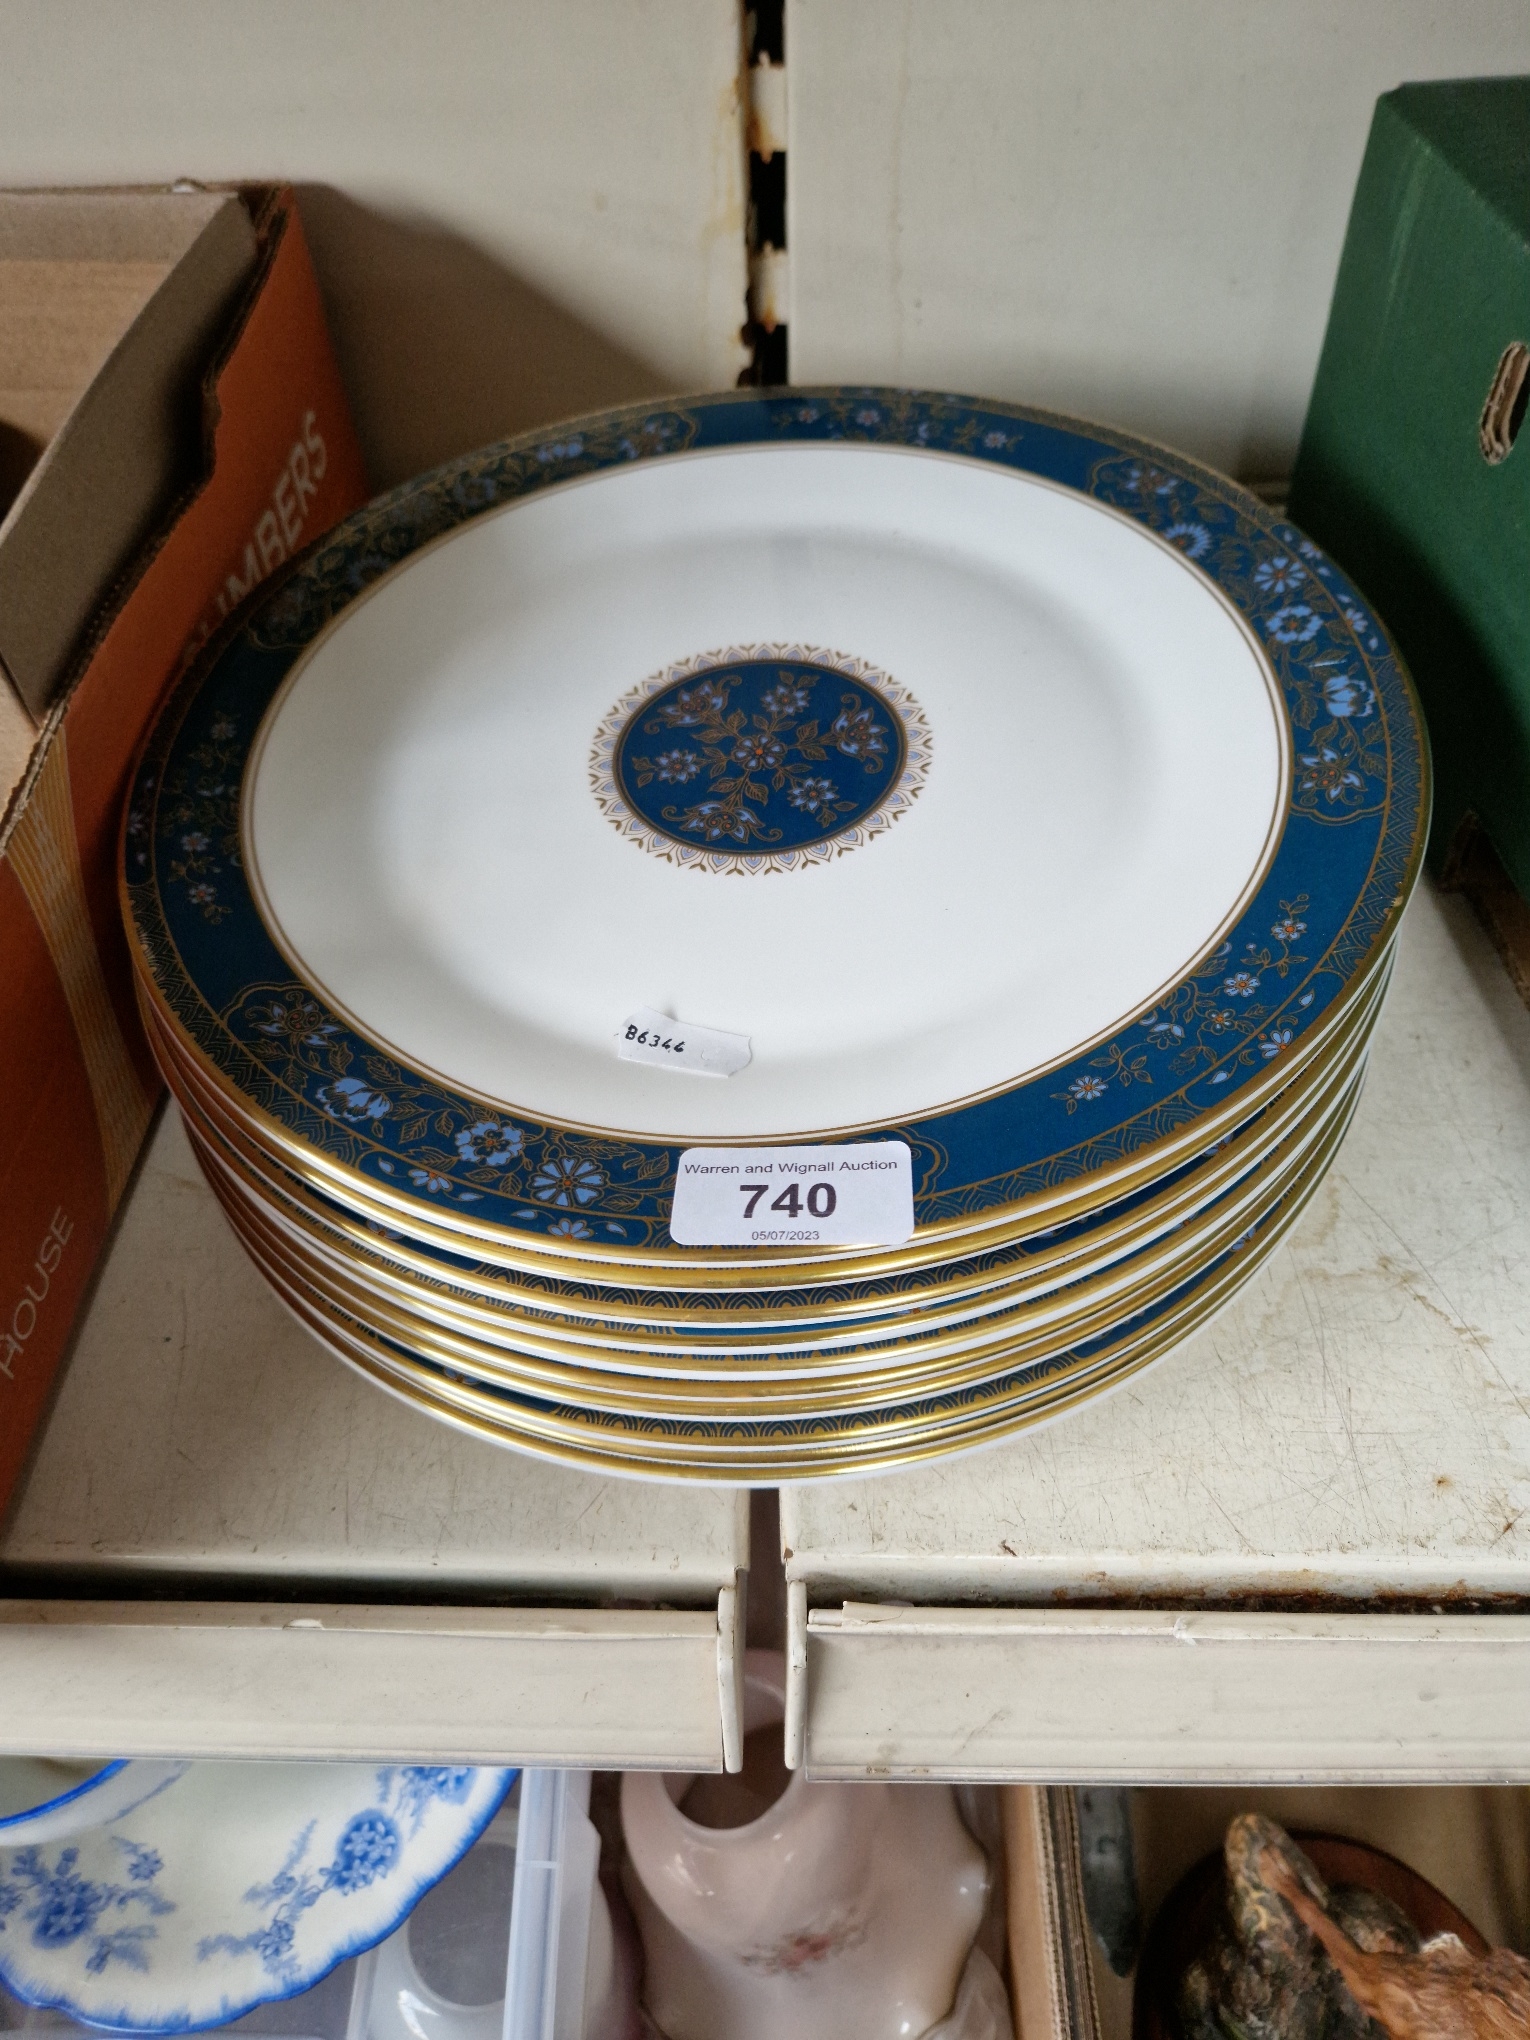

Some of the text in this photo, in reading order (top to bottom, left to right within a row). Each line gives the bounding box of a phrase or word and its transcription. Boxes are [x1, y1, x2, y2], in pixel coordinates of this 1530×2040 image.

[685, 1160, 898, 1175] Warren and Wignall Auction
[739, 1182, 837, 1219] 740
[751, 1230, 820, 1241] 05/07/2023
